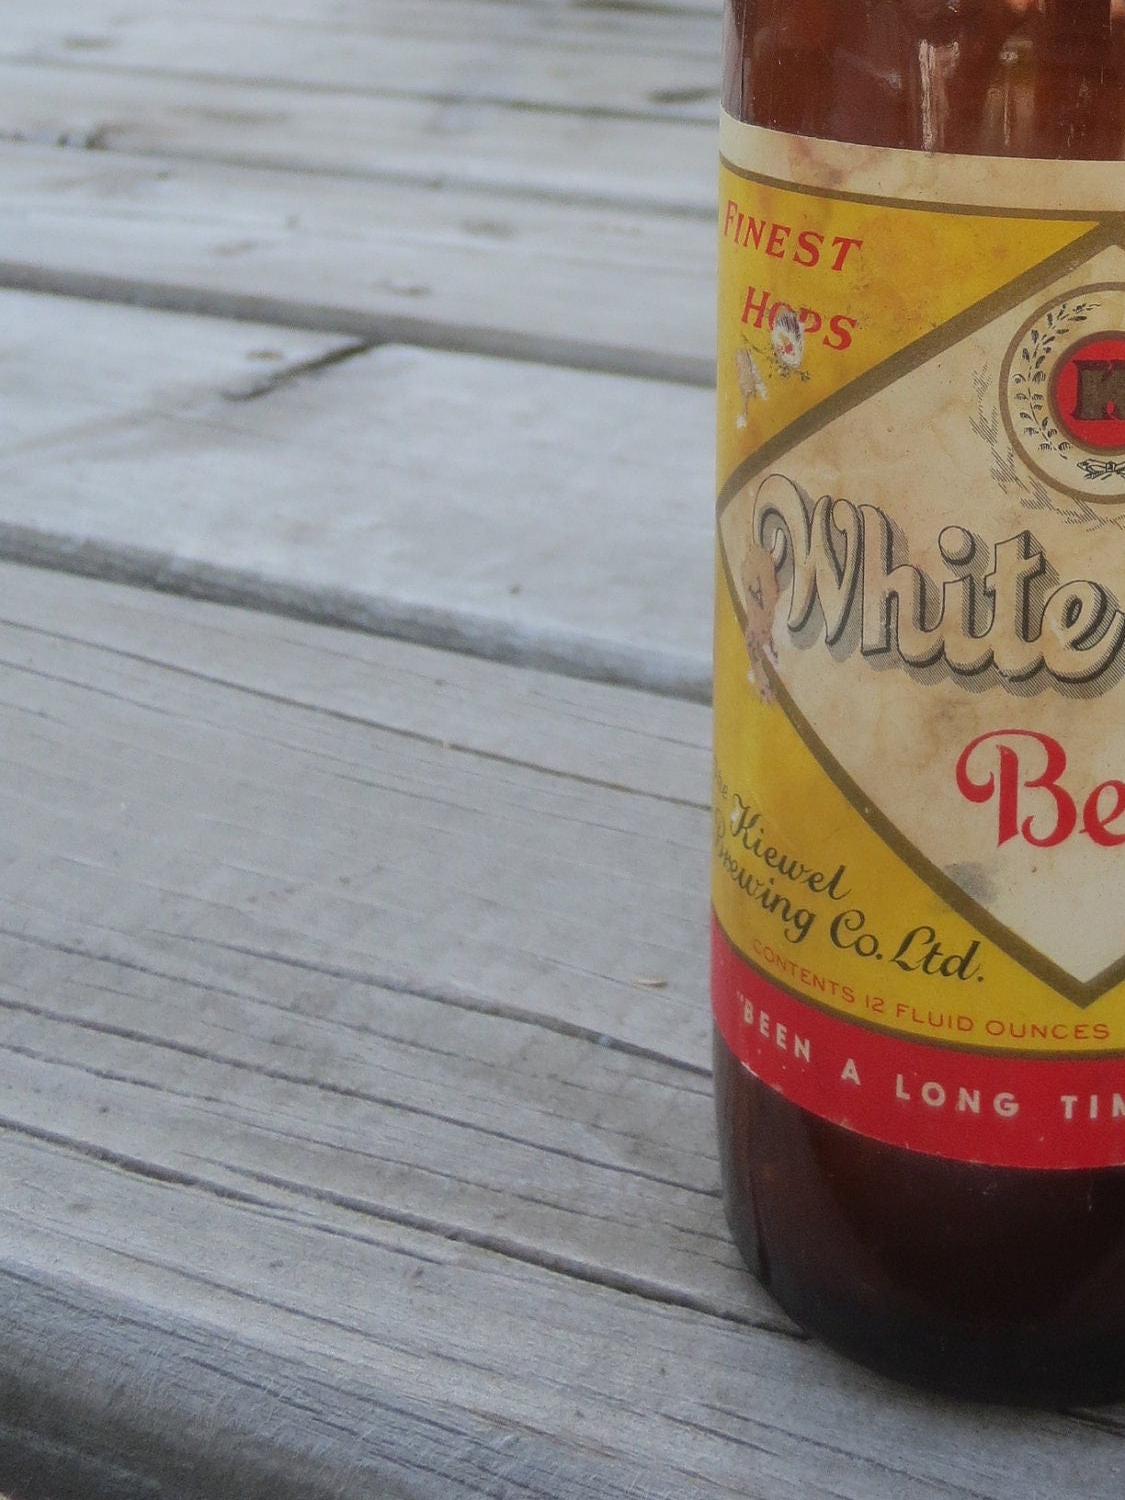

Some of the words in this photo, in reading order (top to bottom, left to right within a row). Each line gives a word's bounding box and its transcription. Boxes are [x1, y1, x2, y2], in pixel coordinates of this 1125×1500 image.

[724, 199, 864, 273] FINEST
[731, 792, 852, 901] Kiewel
[830, 908, 884, 961] Co.
[889, 925, 985, 983] Ltd.
[752, 937, 856, 1004] CONTENTS
[865, 993, 885, 1014] 12
[896, 1003, 975, 1033] FLUID
[985, 1019, 1111, 1041] OUNCES
[840, 1058, 861, 1087] A
[895, 1073, 1021, 1118] LONG
